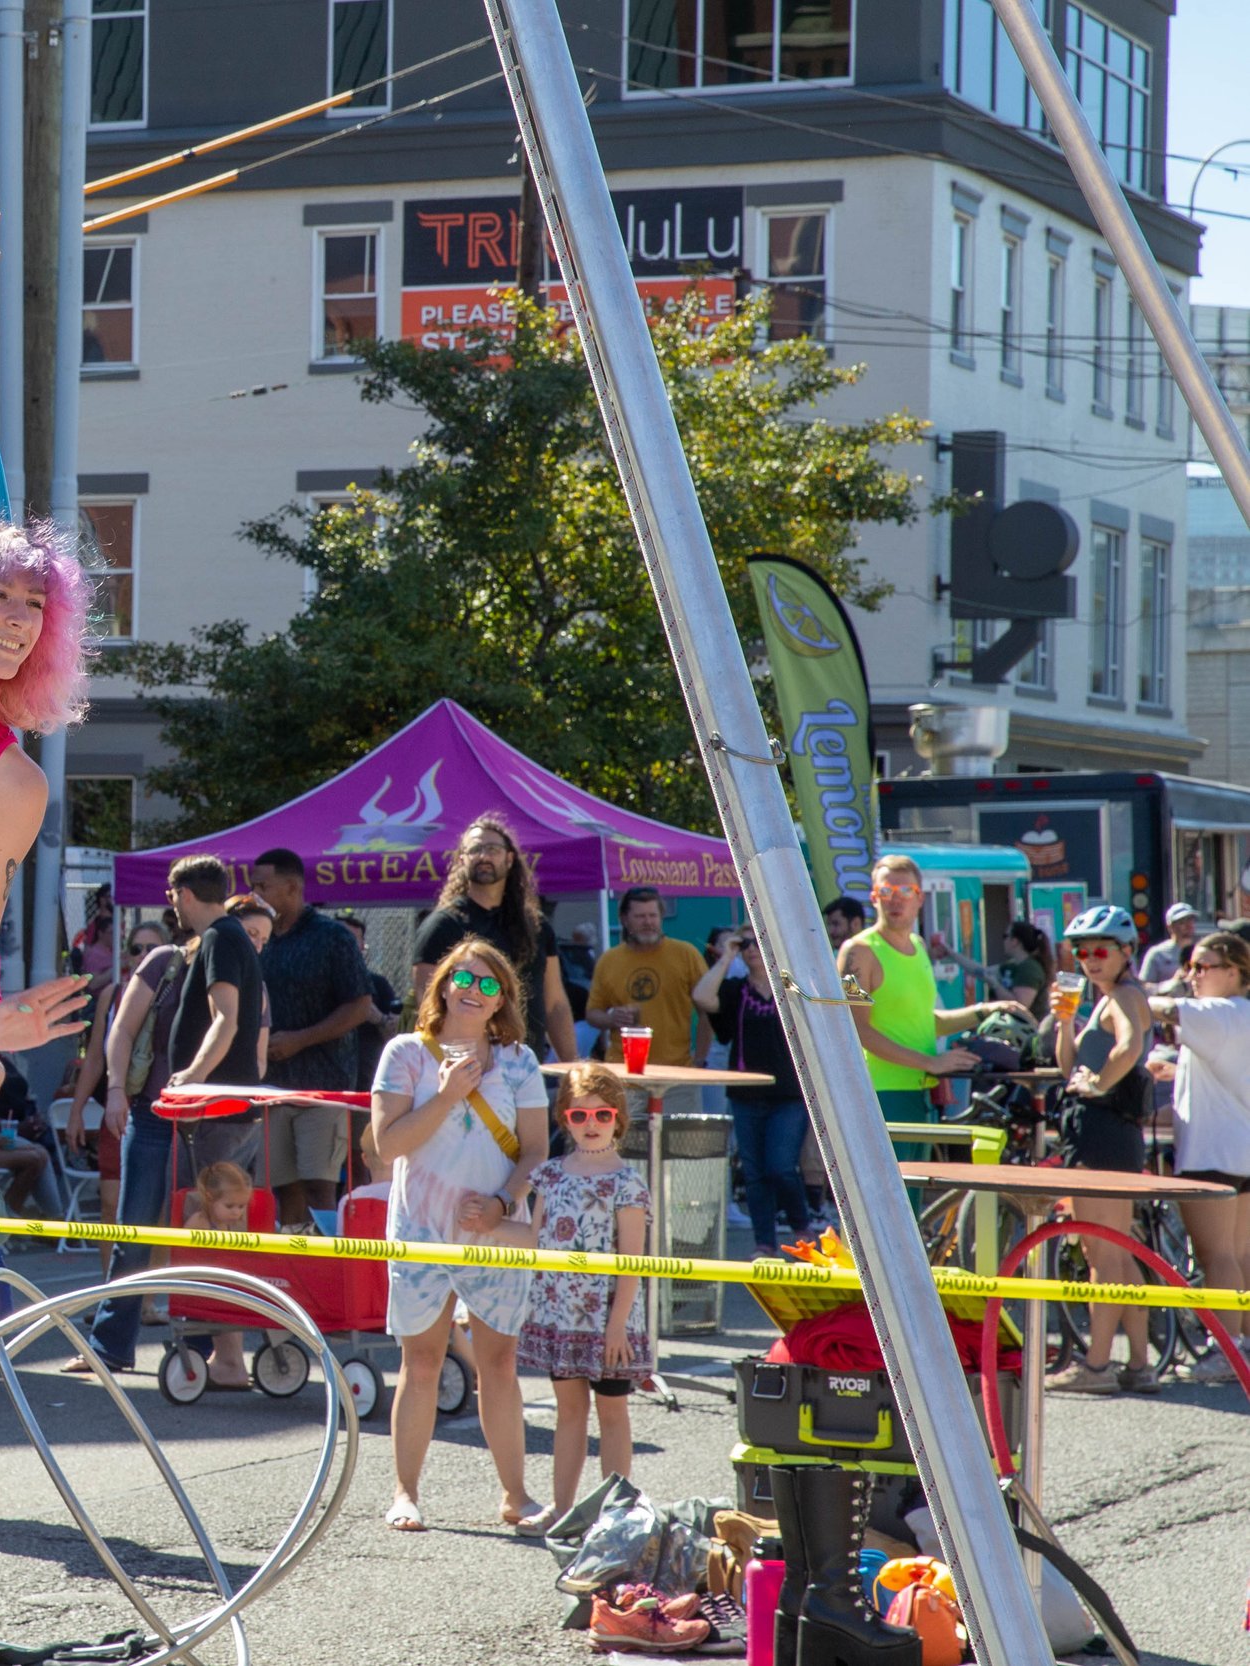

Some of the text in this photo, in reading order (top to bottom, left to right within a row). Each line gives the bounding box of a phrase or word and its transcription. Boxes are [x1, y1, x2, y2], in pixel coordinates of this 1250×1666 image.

[421, 303, 516, 326] PLEASE
[619, 847, 699, 887] Louisiana
[828, 1376, 871, 1392] RYOBI
